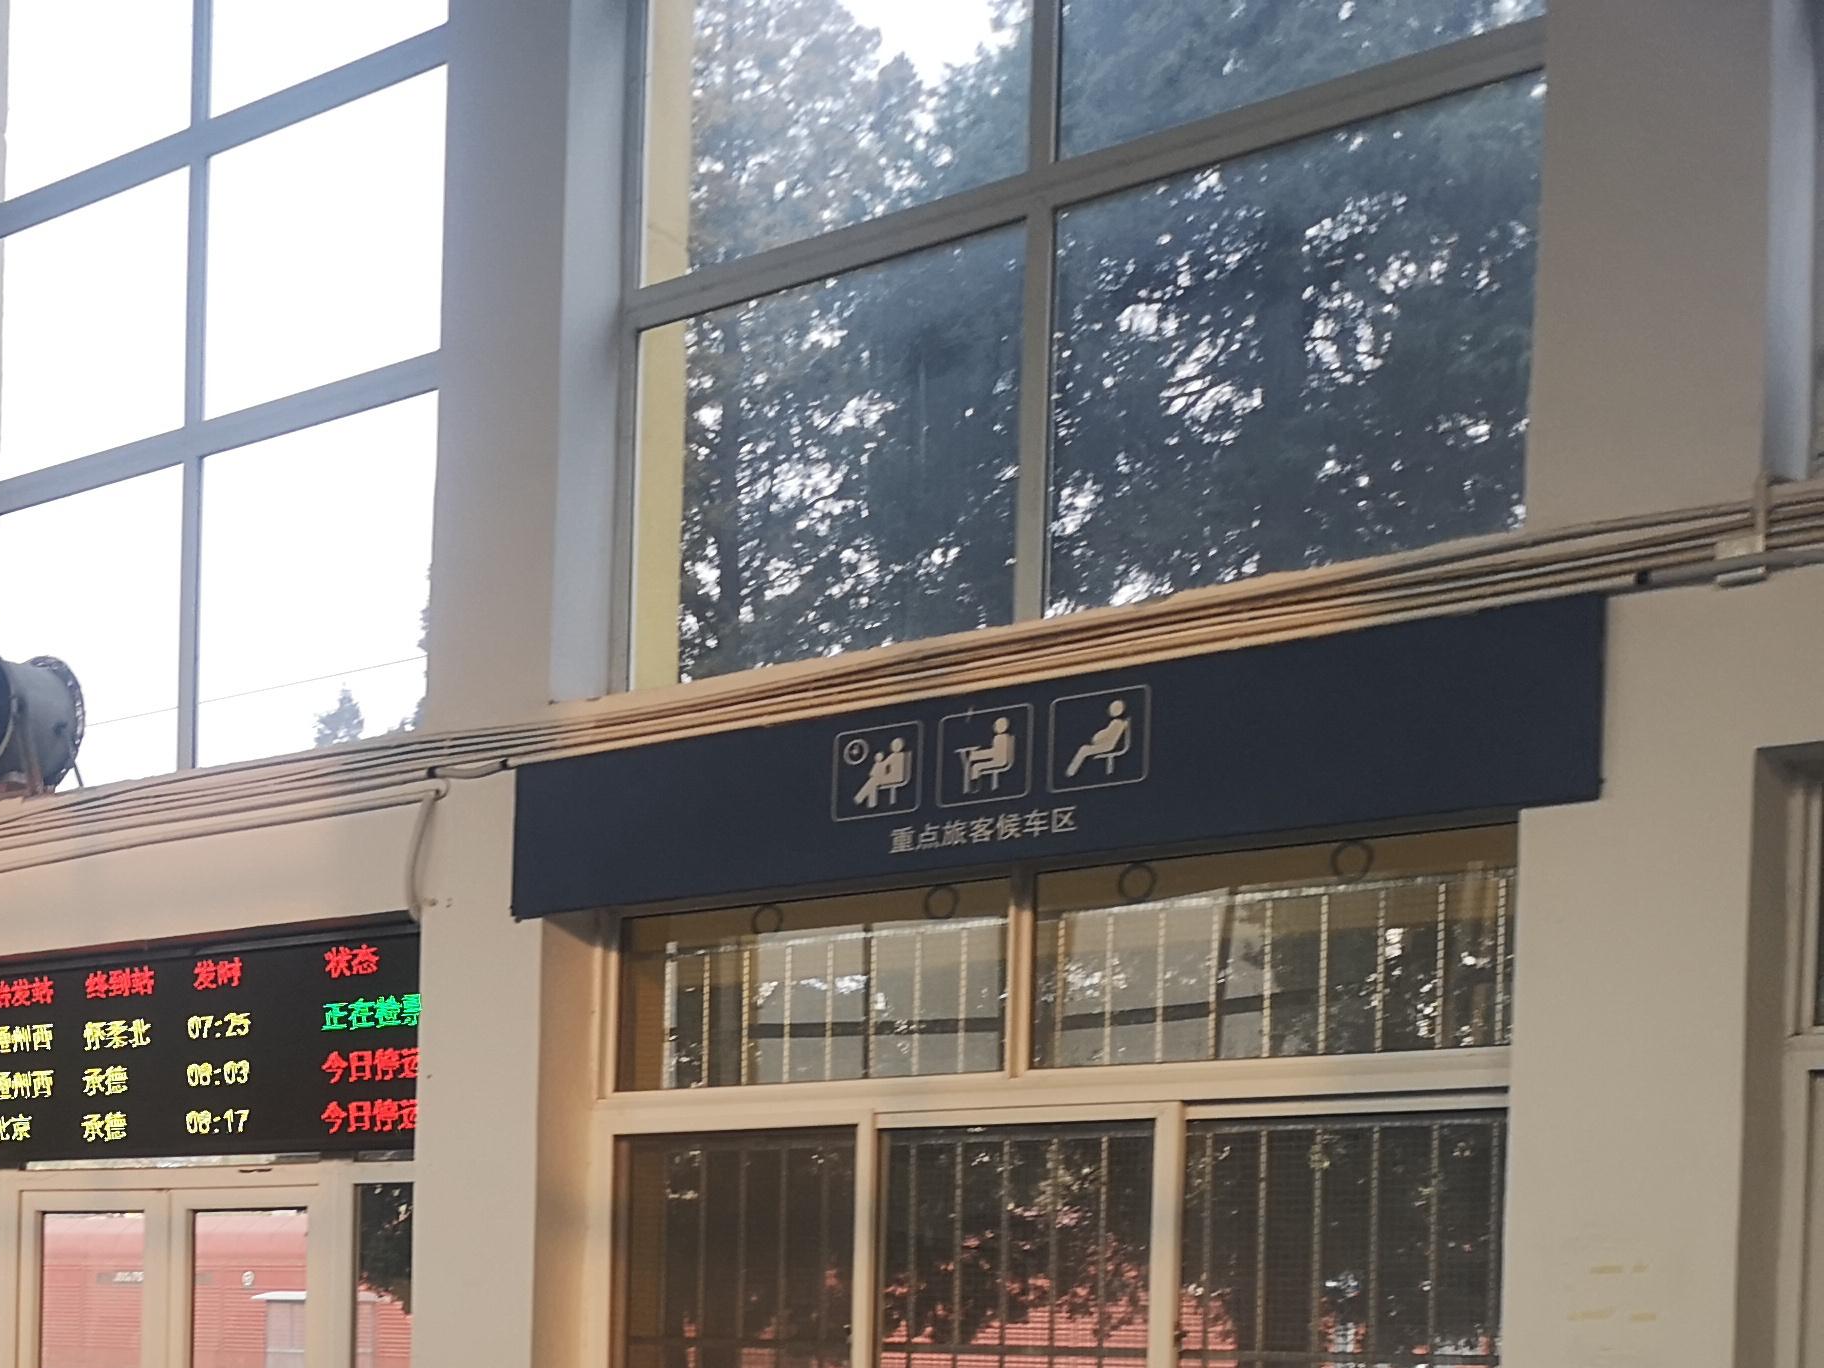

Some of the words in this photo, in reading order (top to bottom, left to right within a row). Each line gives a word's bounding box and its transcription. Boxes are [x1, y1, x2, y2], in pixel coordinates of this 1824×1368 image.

[889, 806, 1078, 854] 重点旅客候车区
[85, 966, 155, 999] 终到站
[194, 957, 243, 990] 发时
[324, 944, 380, 978] 状态
[83, 1018, 151, 1051] 怀柔北
[188, 1012, 251, 1039] 07:25
[321, 994, 421, 1031] 正在检票
[82, 1065, 128, 1096] 承德
[187, 1060, 250, 1086] 08:03
[321, 1048, 420, 1084] 今日停运
[81, 1110, 127, 1142] 承德
[186, 1108, 250, 1134] 08:17
[321, 1098, 418, 1134] 今日停运
